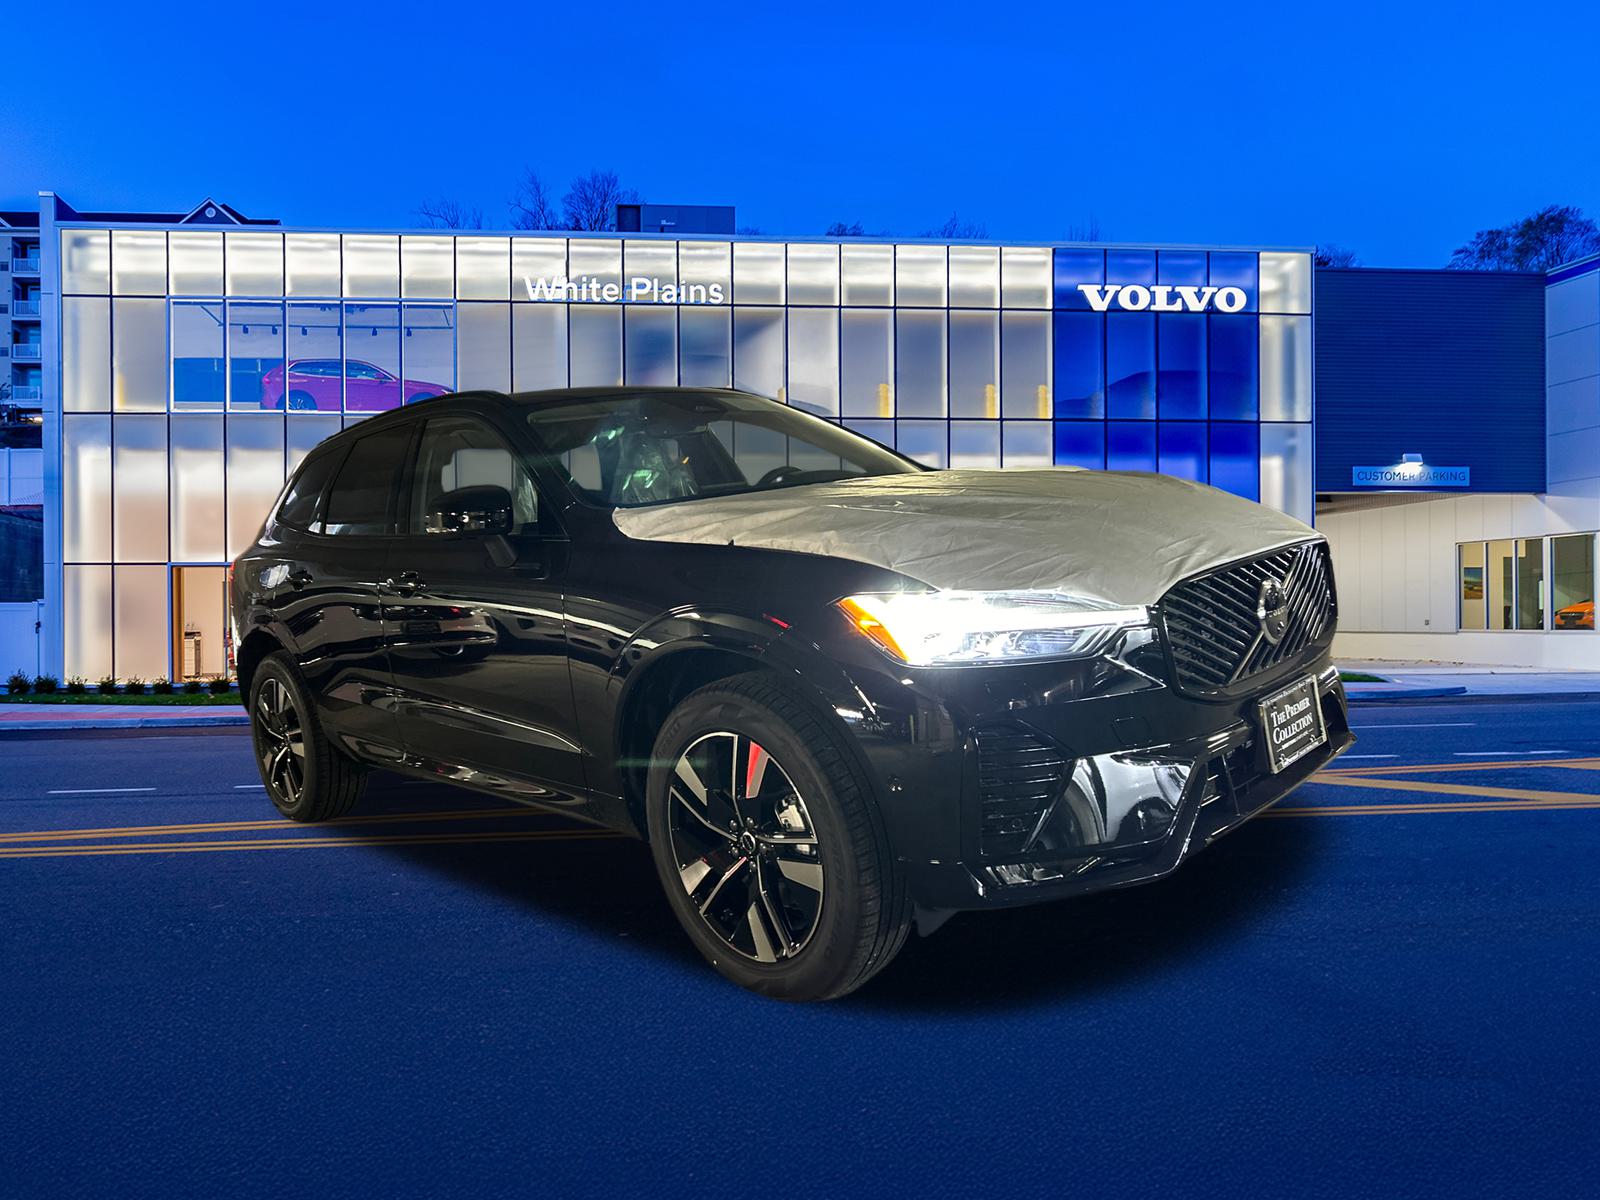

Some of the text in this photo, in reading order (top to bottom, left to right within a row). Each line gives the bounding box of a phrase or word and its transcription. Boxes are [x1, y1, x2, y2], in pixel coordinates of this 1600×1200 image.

[524, 275, 725, 304] White Plains
[1077, 284, 1247, 312] VOLVO
[1357, 471, 1466, 481] CUSTOMER PARKING
[1271, 697, 1311, 727] THE PREMIER
[1273, 712, 1314, 745] COLLECTION
